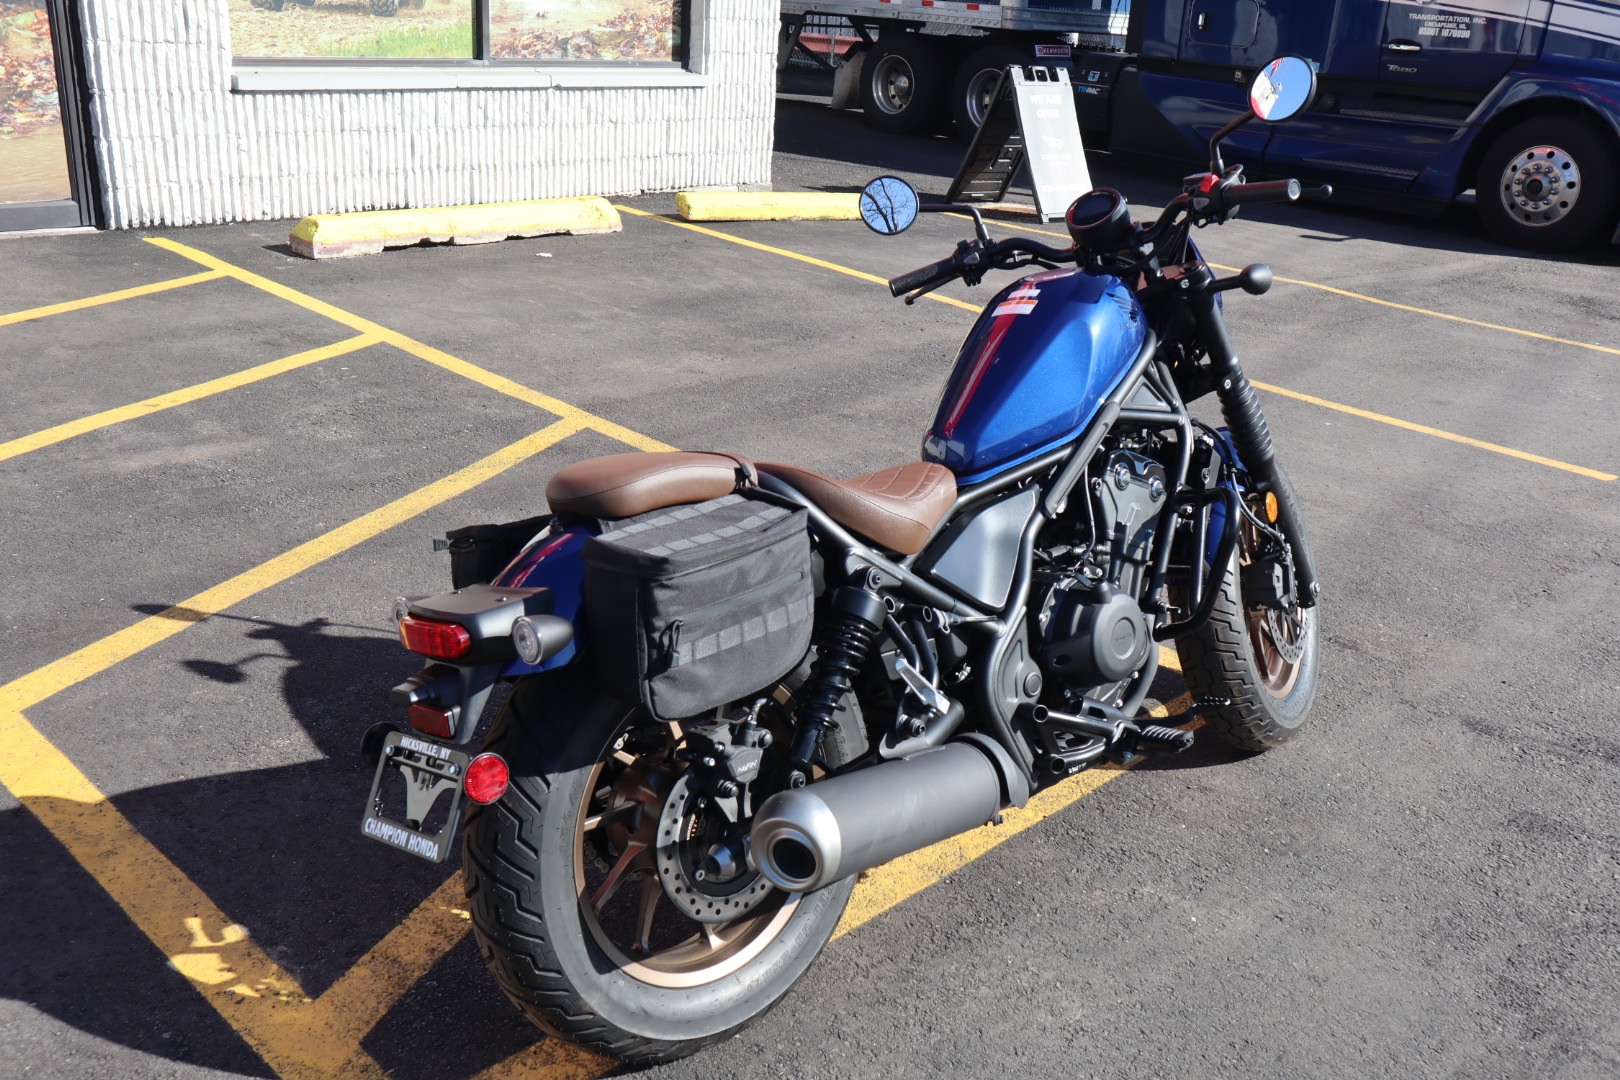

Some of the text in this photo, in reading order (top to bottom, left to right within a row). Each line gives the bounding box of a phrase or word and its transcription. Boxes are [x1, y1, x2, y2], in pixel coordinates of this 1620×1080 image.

[1409, 13, 1487, 25] TRANSPORTATION, INC.
[1418, 27, 1440, 36] USDOT
[1029, 94, 1063, 105] WE ARE
[1036, 108, 1060, 118] OPEN
[401, 736, 452, 760] HICKSVILLE, NY
[364, 817, 439, 860] CHAMPION HONDA
